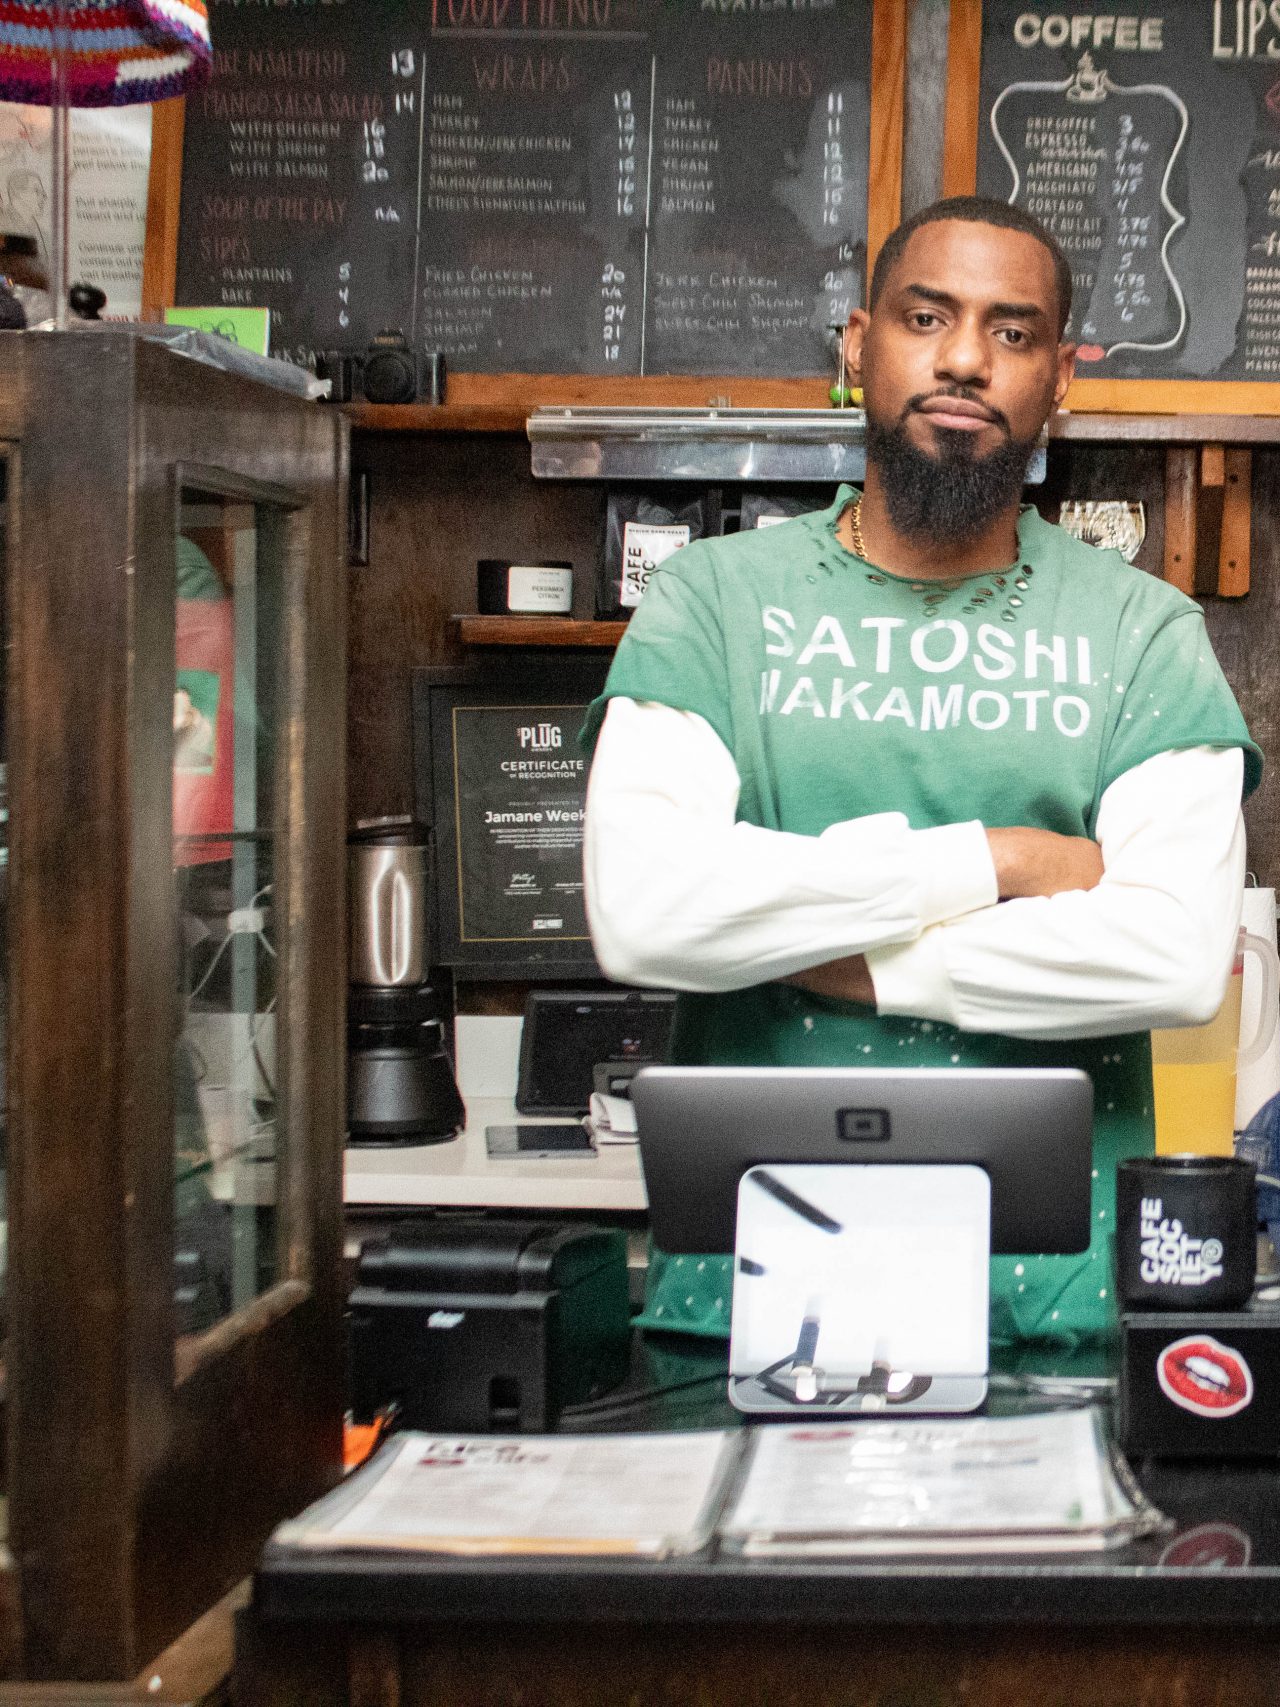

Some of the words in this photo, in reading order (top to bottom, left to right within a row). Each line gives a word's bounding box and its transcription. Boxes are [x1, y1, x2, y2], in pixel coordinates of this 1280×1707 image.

[1013, 13, 1164, 50] COFFEE
[473, 55, 571, 91] WRAPS
[706, 57, 812, 96] PANINIS
[395, 91, 414, 115] 14
[827, 92, 843, 114] 11
[276, 121, 341, 138] CHICKEN
[363, 117, 386, 138] 16
[827, 117, 841, 136] 11
[1025, 132, 1088, 149] ESPRESSO
[362, 160, 389, 183] 20
[1026, 162, 1098, 177] AMERICANO
[617, 174, 635, 194] 16
[1026, 181, 1097, 195] MACCHIATO
[616, 194, 633, 216] 16
[1028, 199, 1084, 214] CORTADO
[602, 263, 625, 283] 20
[338, 286, 350, 304] 4
[338, 310, 350, 328] 6
[604, 304, 626, 322] 24
[603, 325, 621, 340] 21
[626, 547, 642, 596] CAFE
[762, 605, 1092, 685] SATOSHI
[500, 760, 585, 772] CERTIFICATE
[518, 771, 577, 780] RECOGNITION
[484, 811, 544, 824] Jamane
[1140, 1197, 1163, 1284] CAFE
[1159, 1218, 1183, 1285] SOC
